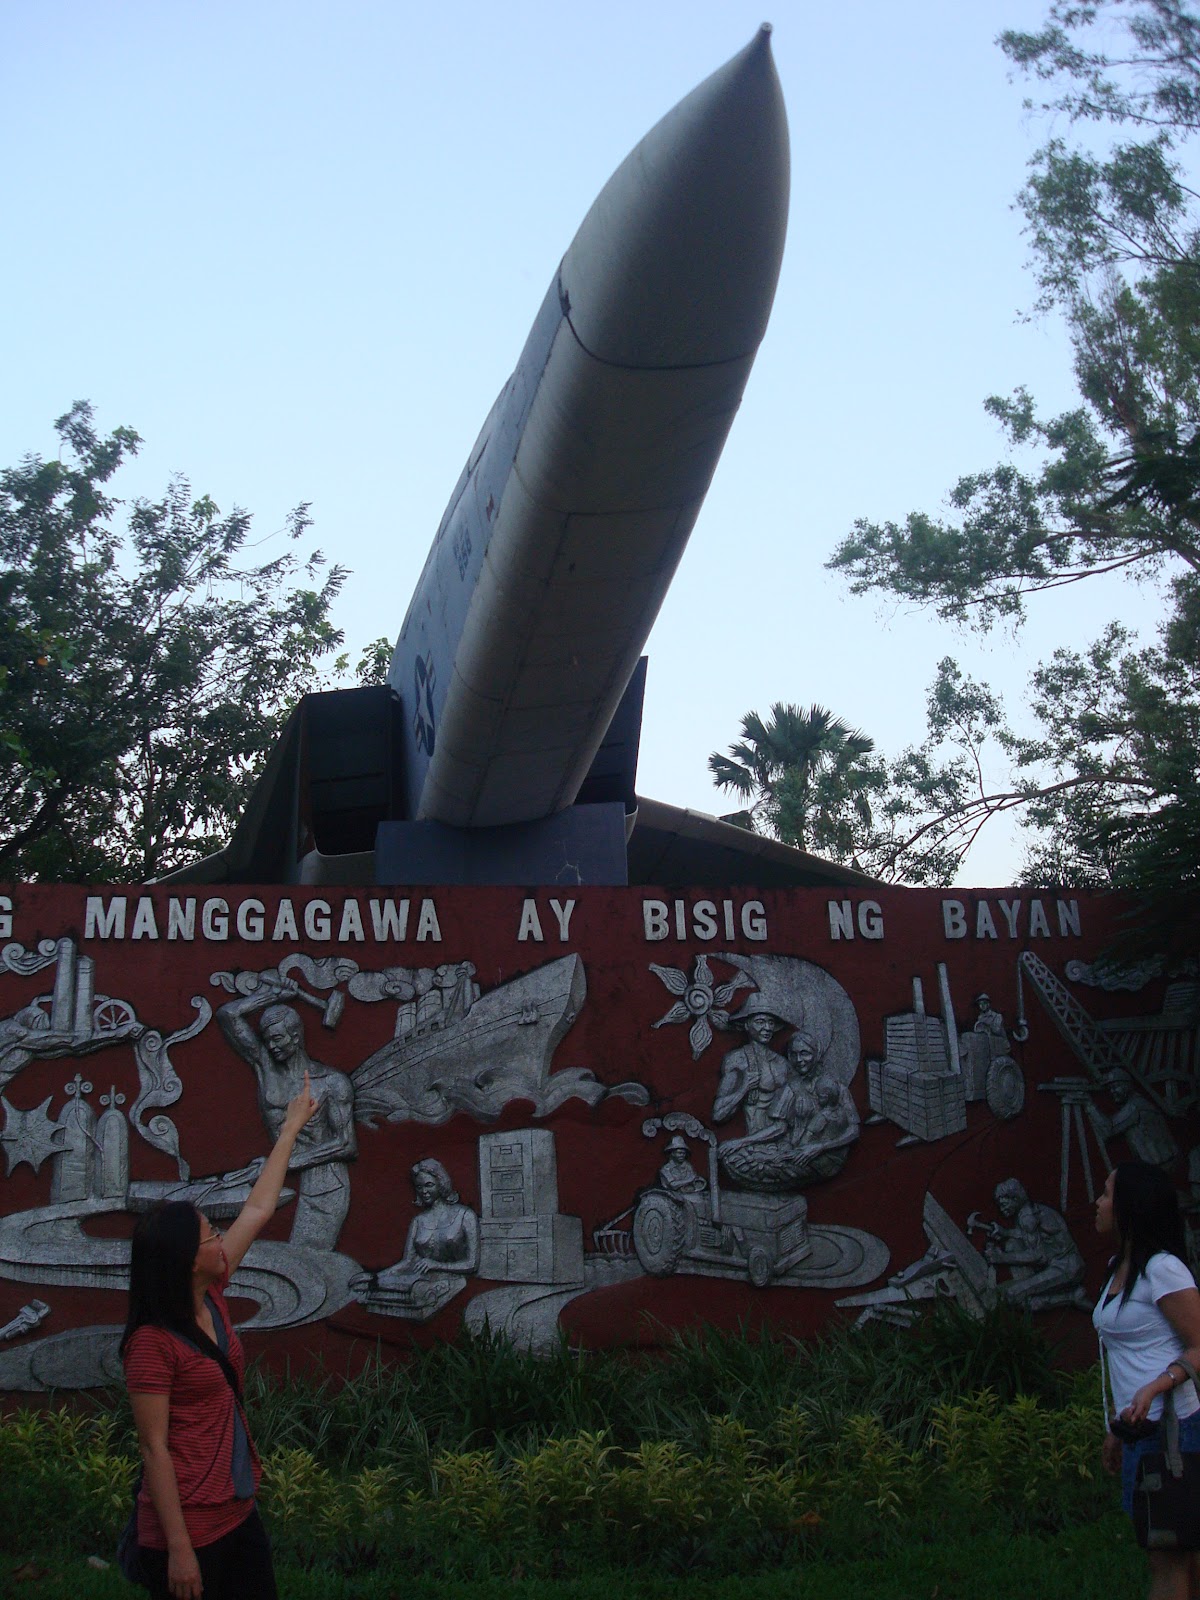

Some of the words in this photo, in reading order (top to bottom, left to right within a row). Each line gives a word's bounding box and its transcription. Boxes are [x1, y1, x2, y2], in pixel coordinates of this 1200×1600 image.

[84, 896, 442, 942] MANGGAGAWA
[517, 898, 577, 942] AY
[642, 898, 769, 942] BISIG
[827, 900, 884, 941] NG
[941, 899, 1082, 939] BAYAN
